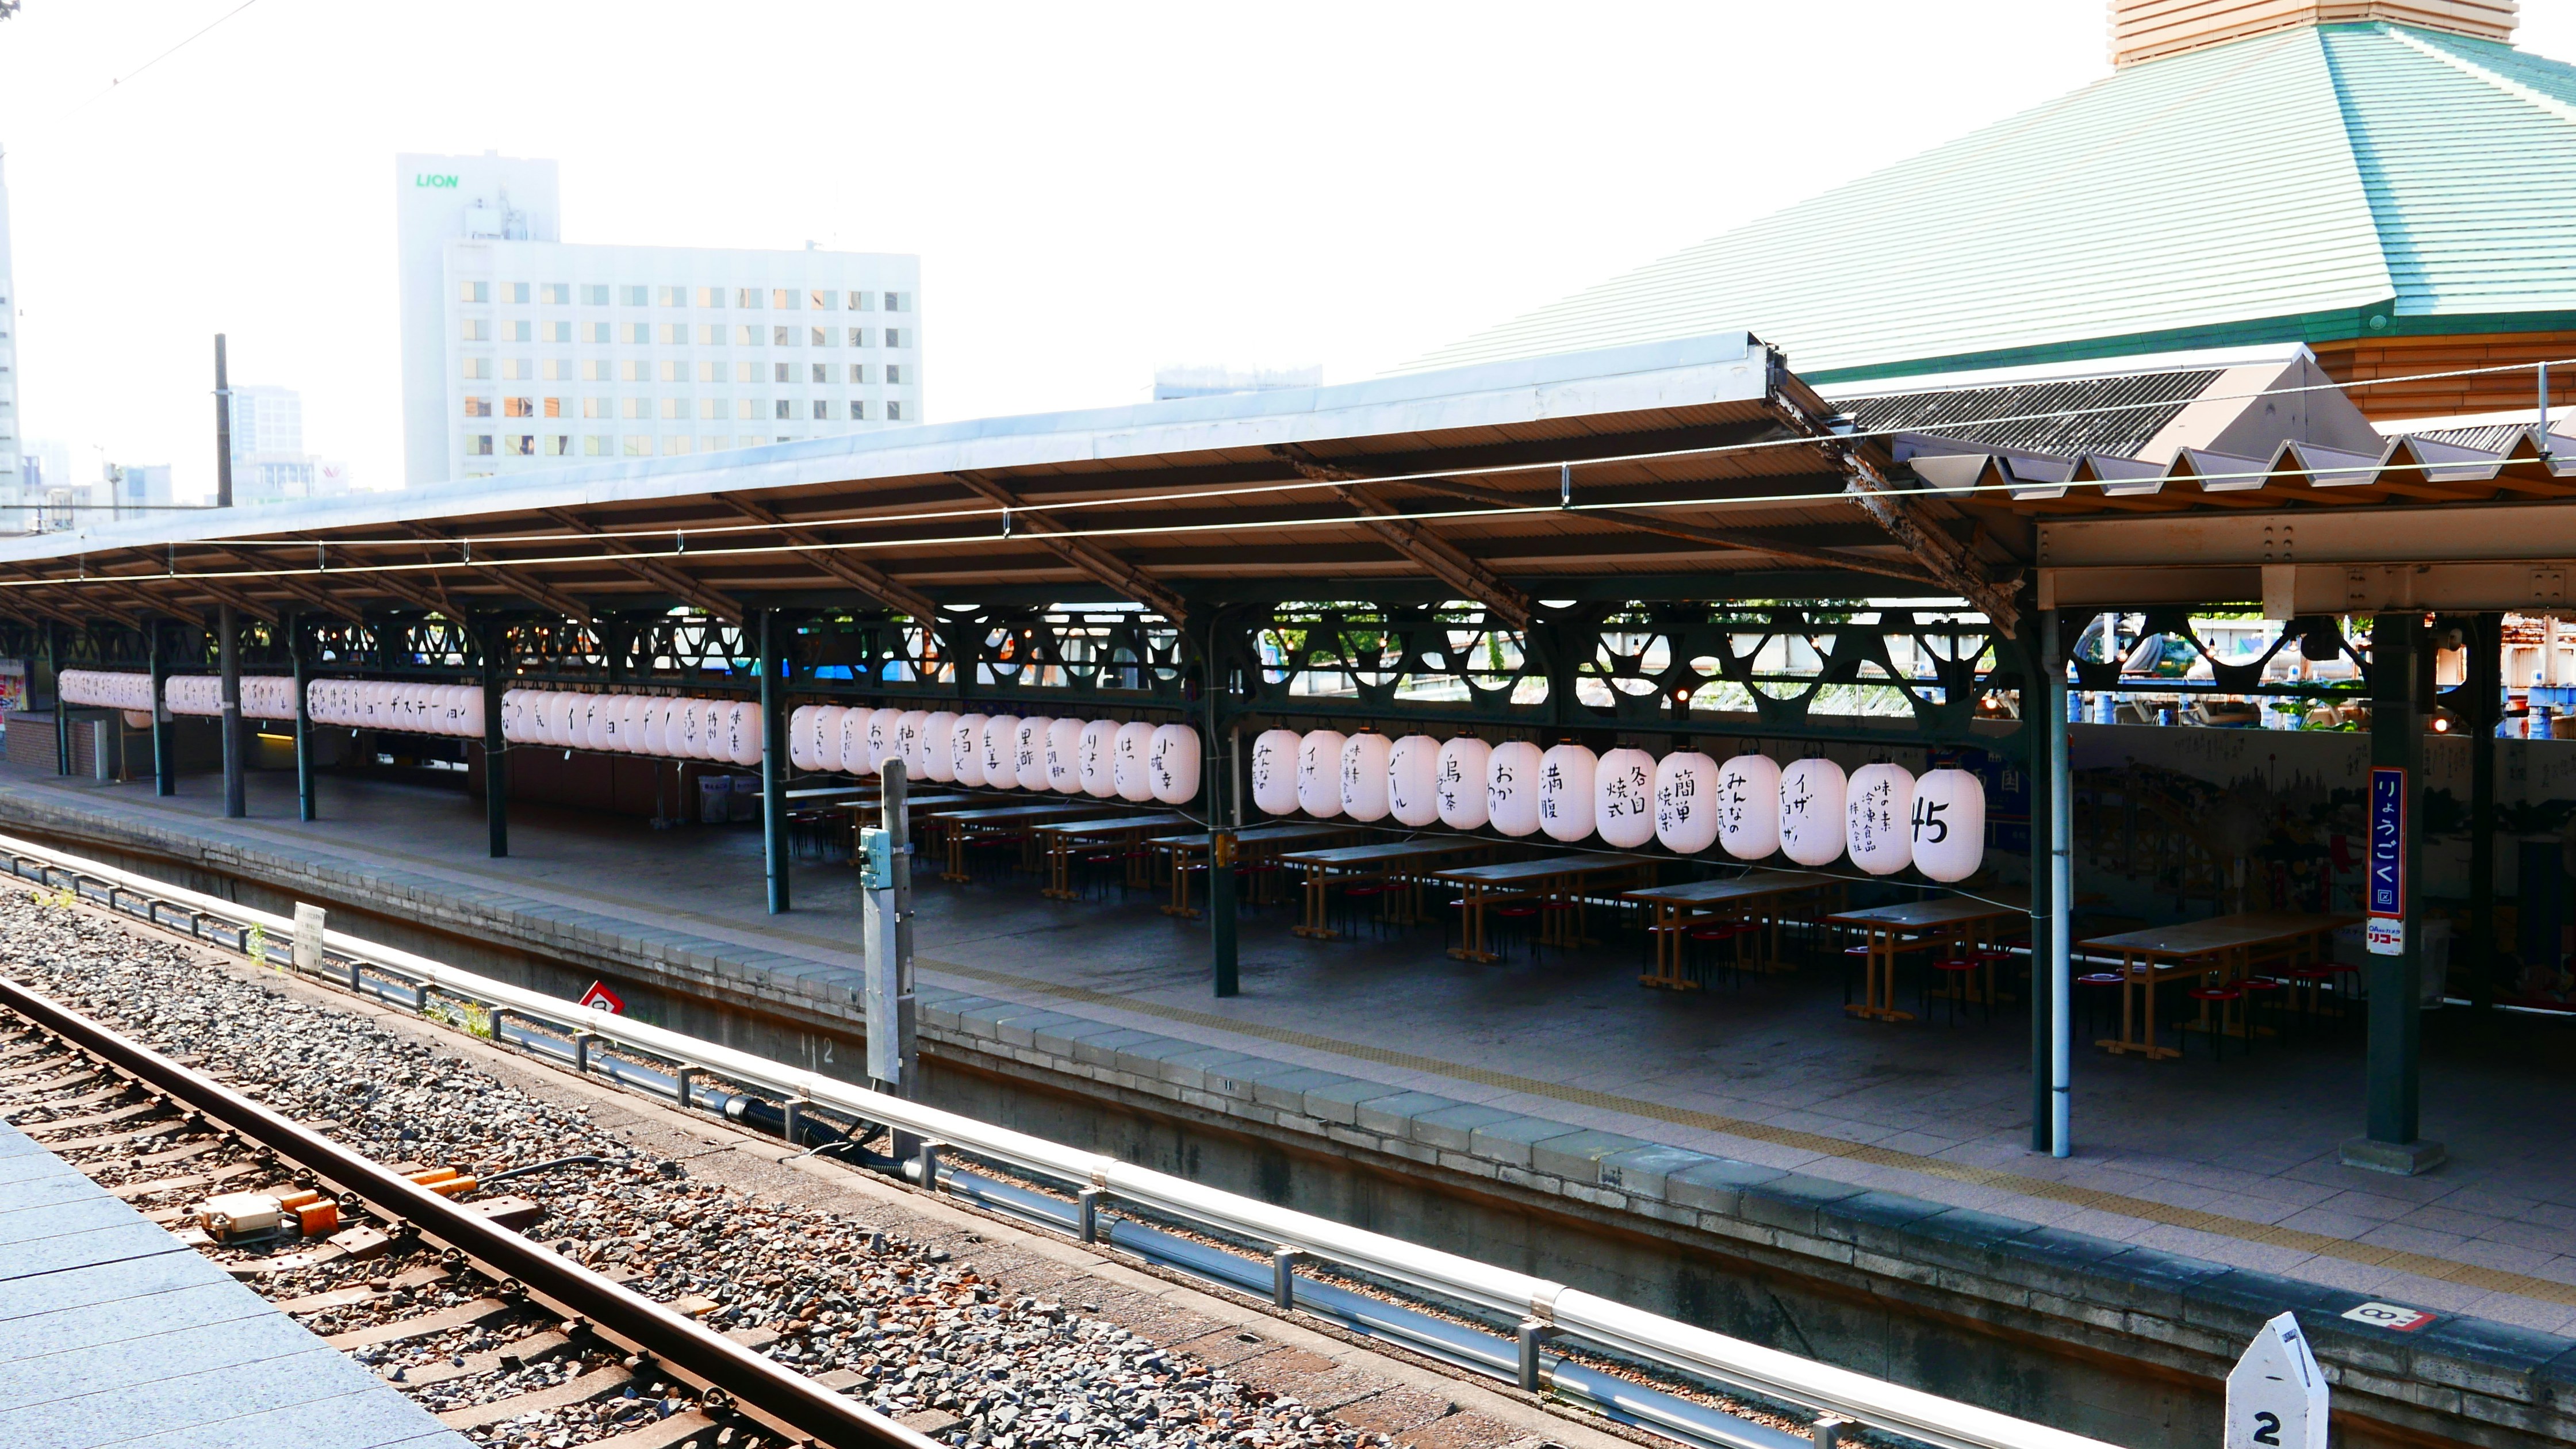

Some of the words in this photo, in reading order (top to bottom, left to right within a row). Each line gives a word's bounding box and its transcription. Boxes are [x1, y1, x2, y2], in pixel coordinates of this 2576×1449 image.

[416, 174, 459, 188] LION
[730, 709, 742, 752] 味の素
[1258, 744, 1272, 790] みんなの
[1541, 762, 1563, 819] 満腹
[1674, 769, 1696, 824] 簡単
[1727, 772, 1747, 834] みんなの
[1873, 779, 1892, 832] 味の素
[1911, 796, 1949, 844] 45
[1861, 791, 1876, 853] 冷凍食品
[2376, 780, 2397, 883] りょうごく
[2368, 933, 2401, 944] リコー
[2359, 1308, 2398, 1320] 8
[2253, 1411, 2281, 1447] 2
